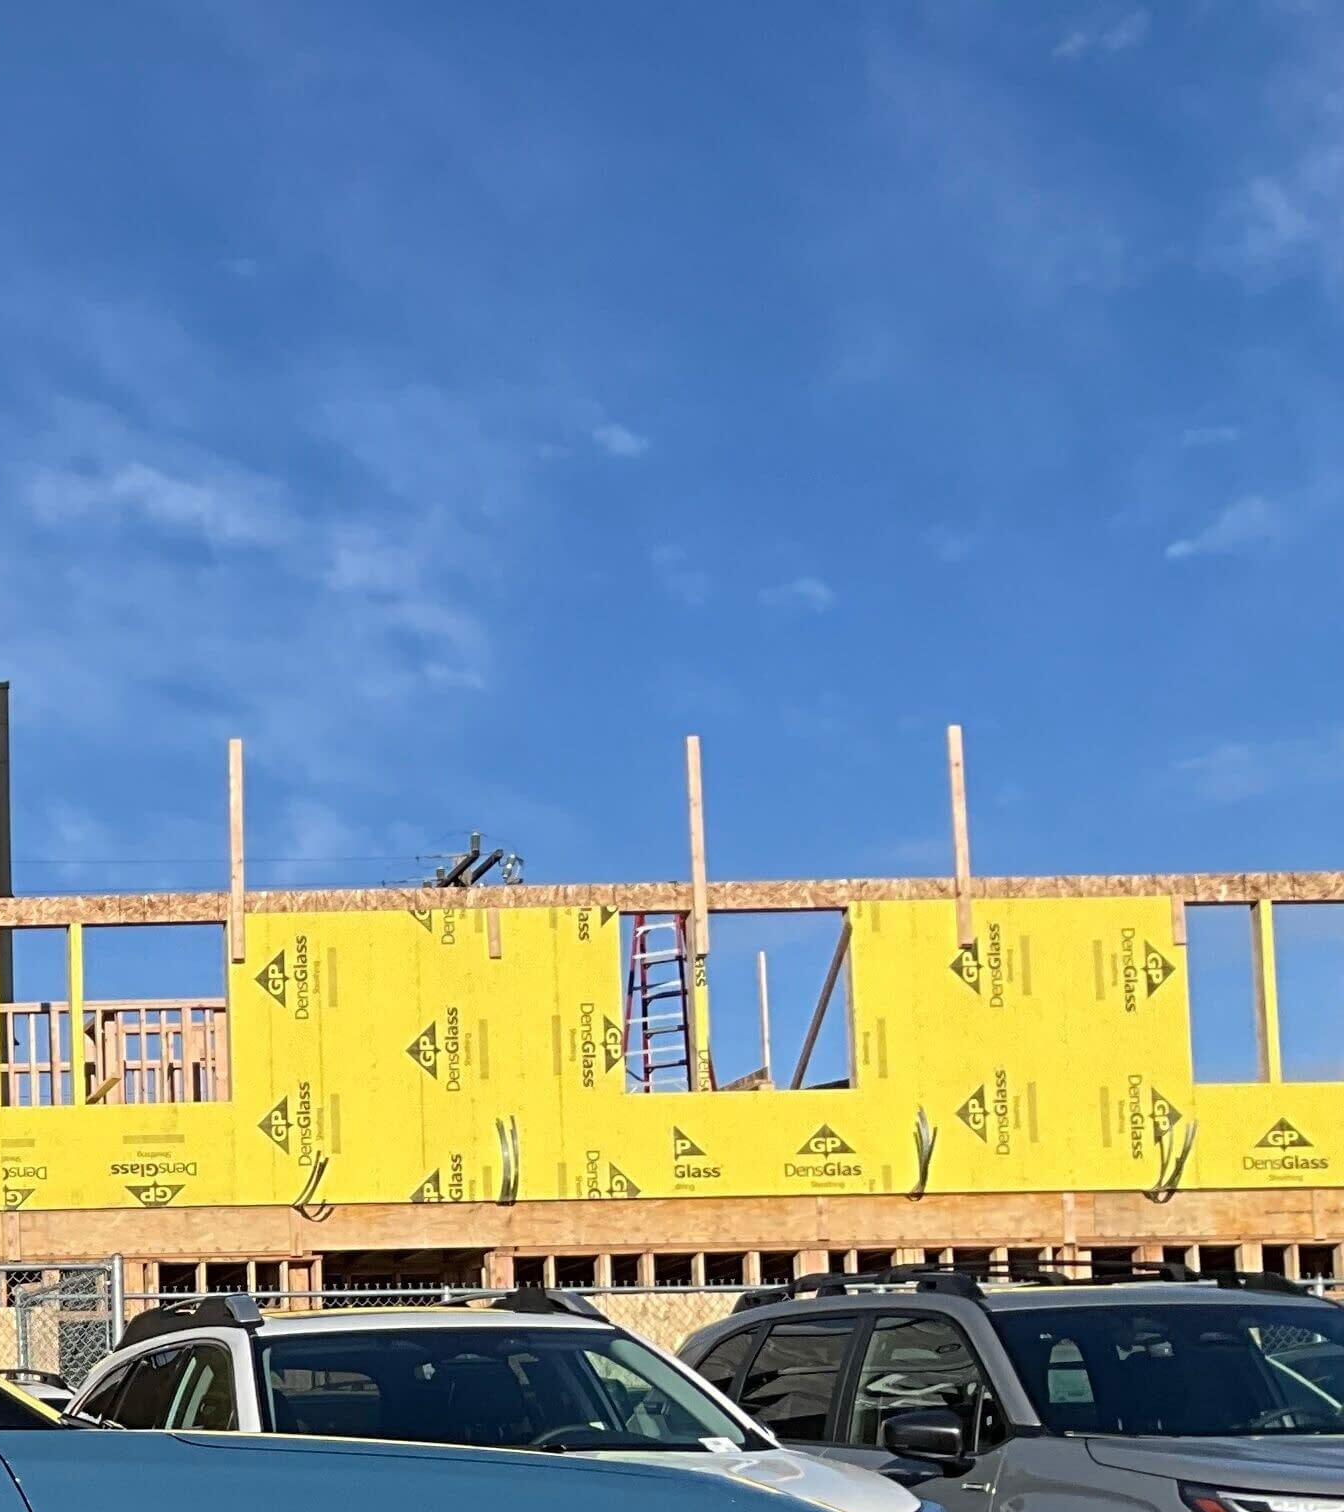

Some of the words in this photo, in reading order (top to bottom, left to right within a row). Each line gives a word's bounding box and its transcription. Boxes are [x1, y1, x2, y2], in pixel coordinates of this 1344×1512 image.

[267, 963, 284, 996] GP
[293, 935, 310, 1020] DensGlass
[962, 951, 978, 984] GP
[986, 922, 1004, 1008] DensGlass
[1120, 927, 1138, 1013] DensGlass
[1147, 952, 1163, 985] GP
[419, 1035, 435, 1067] GP
[445, 1006, 461, 1092] DensGlass
[580, 1002, 596, 1089] DensGlass
[605, 1027, 622, 1059] GP
[271, 1110, 287, 1142] GP
[296, 1081, 313, 1167] DensGlass
[968, 1098, 984, 1130] GP
[993, 1069, 1010, 1155] DensGlass
[1128, 1074, 1144, 1160] DensGlass
[1154, 1099, 1170, 1131] GP
[809, 1137, 841, 1153] GP
[1267, 1130, 1299, 1146] GP
[111, 1162, 198, 1178] DensGlass
[674, 1164, 722, 1179] Glass
[1242, 1155, 1330, 1171] DensGlass
[140, 1186, 173, 1203] GP
